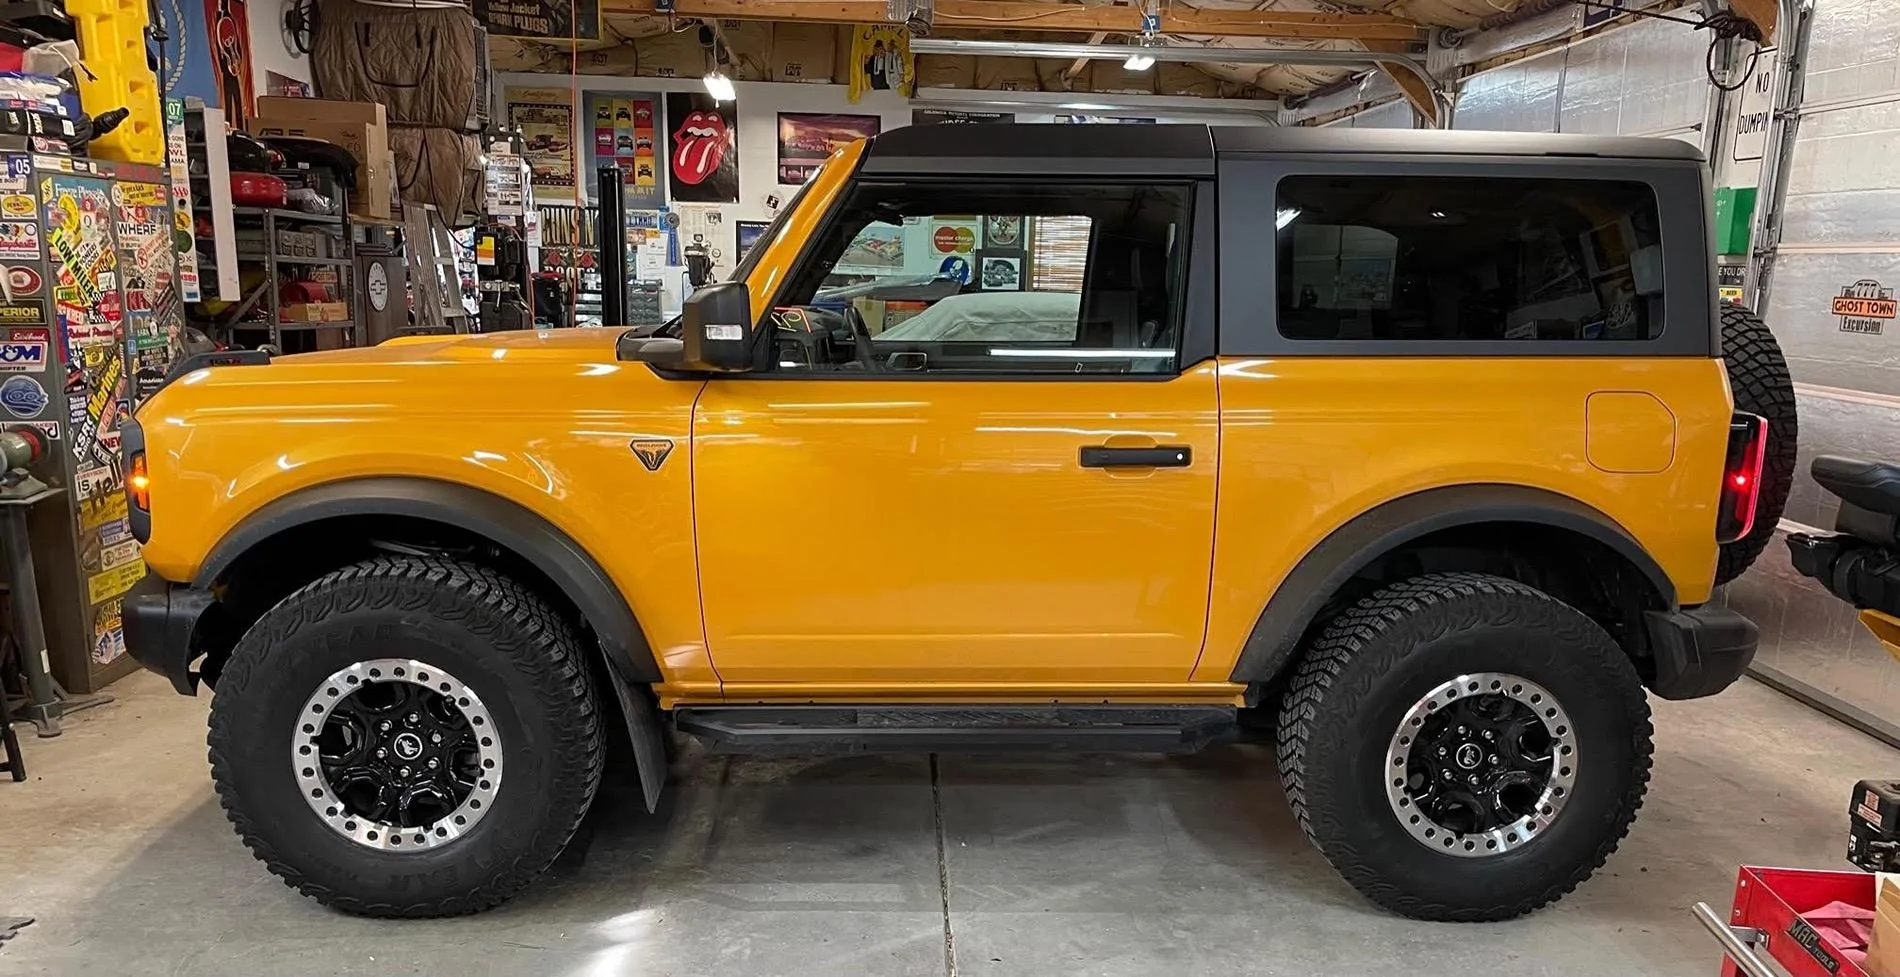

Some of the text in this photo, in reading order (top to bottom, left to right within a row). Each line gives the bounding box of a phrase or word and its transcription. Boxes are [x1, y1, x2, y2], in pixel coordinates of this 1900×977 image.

[510, 3, 541, 15] Jacket
[488, 12, 549, 34] SPARK PLUGS
[1755, 71, 1770, 94] NO
[168, 102, 180, 115] 07
[15, 158, 31, 175] 05
[541, 207, 600, 246] GUNS N'
[54, 234, 75, 265] LOW
[1723, 266, 1736, 277] YOU
[1857, 282, 1878, 298] 777
[1834, 300, 1895, 315] GHOST TOWN
[1843, 316, 1881, 333] Excursion
[87, 355, 121, 421] Marines
[78, 479, 91, 493] IS
[1789, 918, 1818, 949] MAC
[1814, 948, 1836, 970] TOOLS
